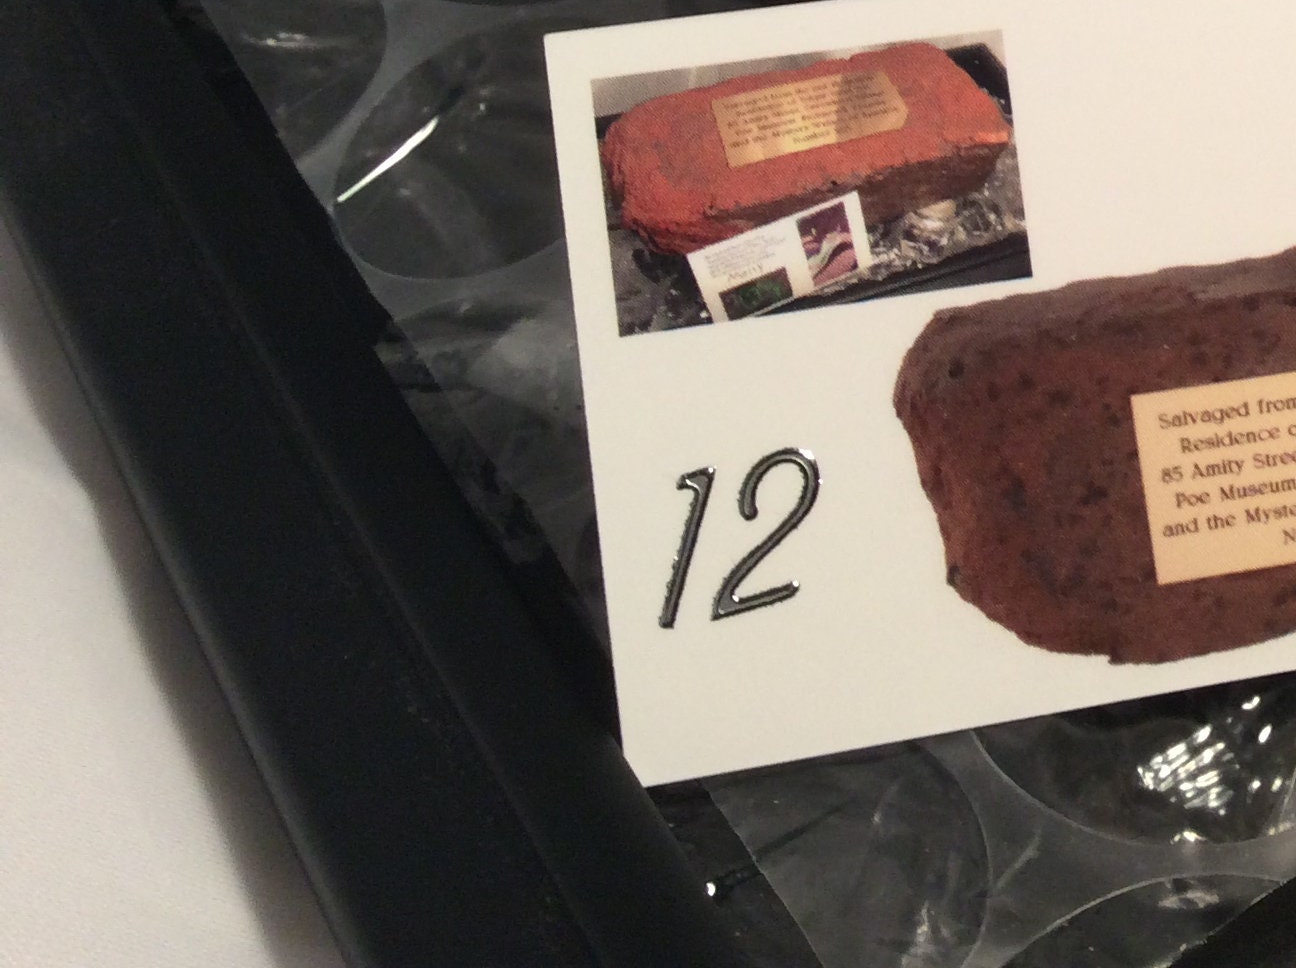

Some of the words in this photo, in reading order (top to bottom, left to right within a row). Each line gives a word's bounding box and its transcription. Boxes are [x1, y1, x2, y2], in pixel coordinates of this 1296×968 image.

[1158, 401, 1250, 430] Salvaged
[1179, 426, 1281, 454] Residence
[1161, 465, 1184, 483] 85
[1192, 458, 1245, 479] Amity
[1175, 490, 1211, 509] Poe
[658, 447, 820, 629] 12
[1162, 517, 1200, 537] and
[1206, 513, 1236, 531] the
